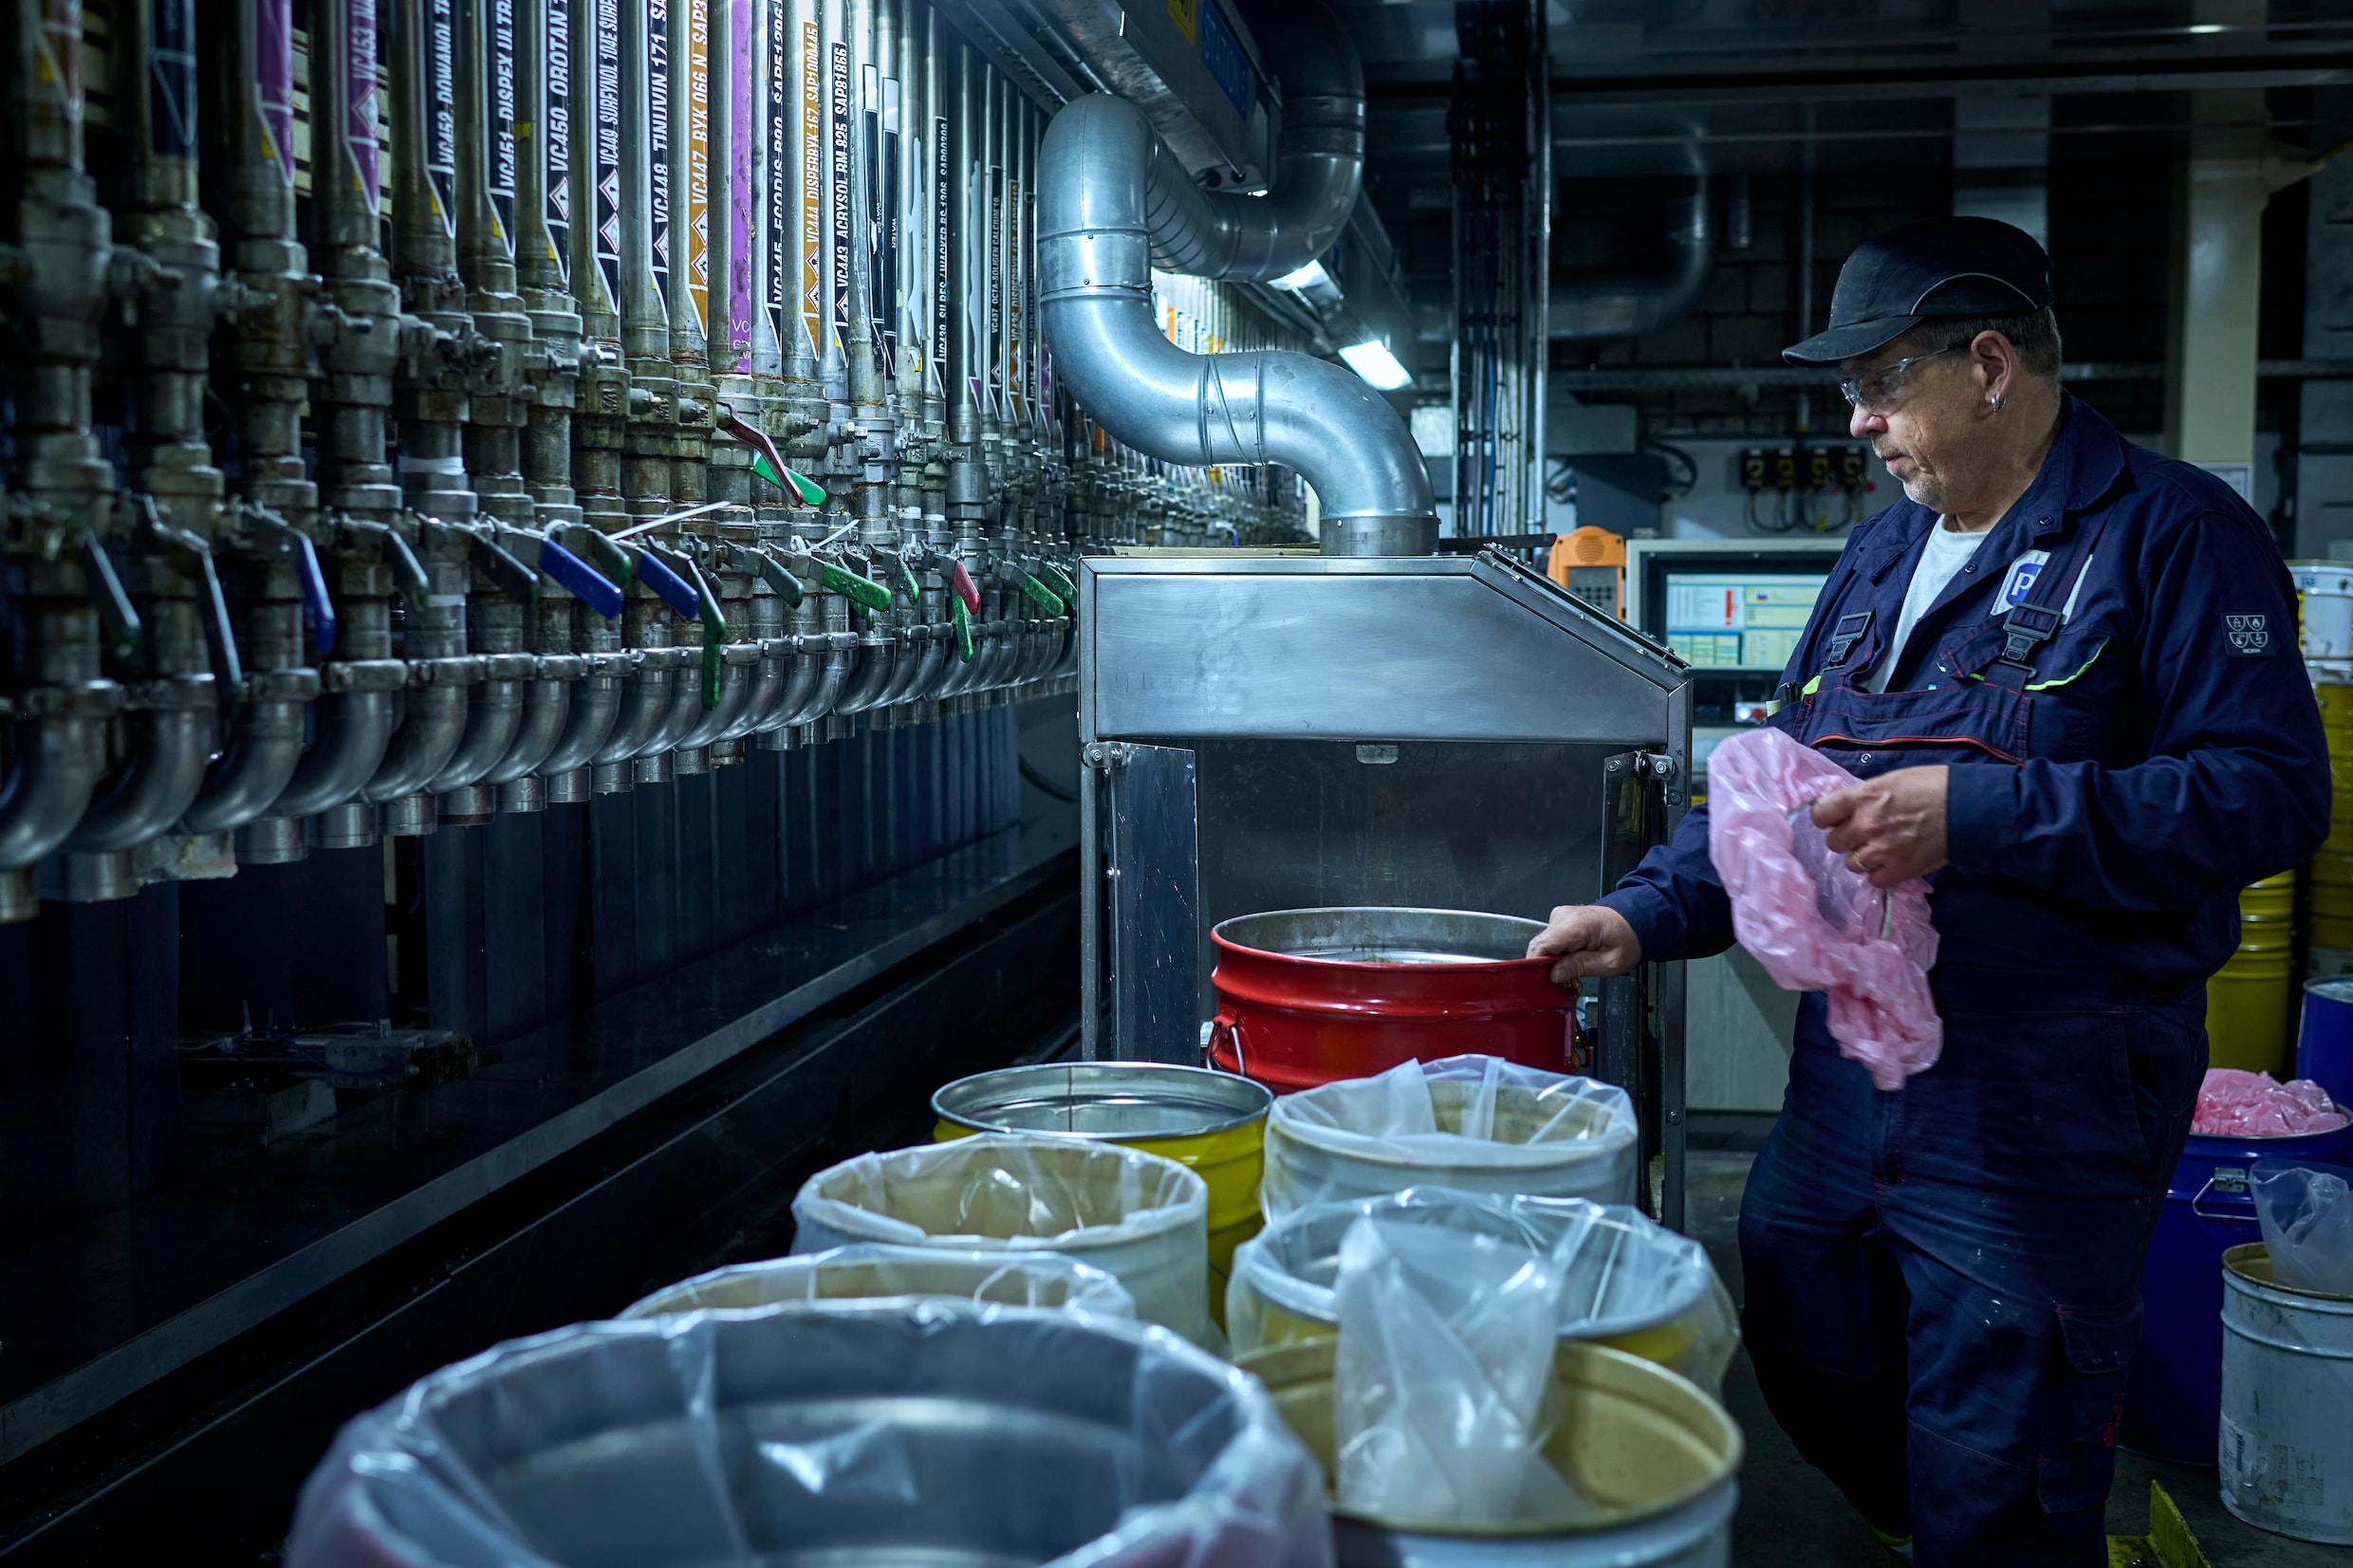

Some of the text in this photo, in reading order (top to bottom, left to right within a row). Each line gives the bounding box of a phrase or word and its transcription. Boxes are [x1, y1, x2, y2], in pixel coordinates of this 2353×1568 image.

[352, 27, 377, 81] VC453
[435, 23, 454, 104] DOWANOL
[549, 9, 569, 97] OROTAN
[599, 31, 618, 61] 104E
[651, 33, 667, 66] 171
[693, 54, 708, 68] N
[806, 28, 819, 102] SAP1000445
[497, 52, 514, 121] DISPEX
[599, 65, 619, 125] SURFYNOL
[693, 71, 708, 104] 066
[834, 47, 847, 117] SAP81866
[437, 111, 454, 165] VC452
[549, 106, 569, 172] VC450
[652, 73, 668, 152] TINUVIN
[693, 107, 708, 142] BYK
[499, 132, 515, 187] VC451
[599, 128, 620, 166] VC449
[653, 163, 669, 223] VC448
[692, 151, 708, 204] VC447
[806, 207, 820, 243] VC444
[836, 177, 848, 239] ACRYSOL
[837, 246, 849, 287] VC443
[991, 307, 999, 334] VC437
